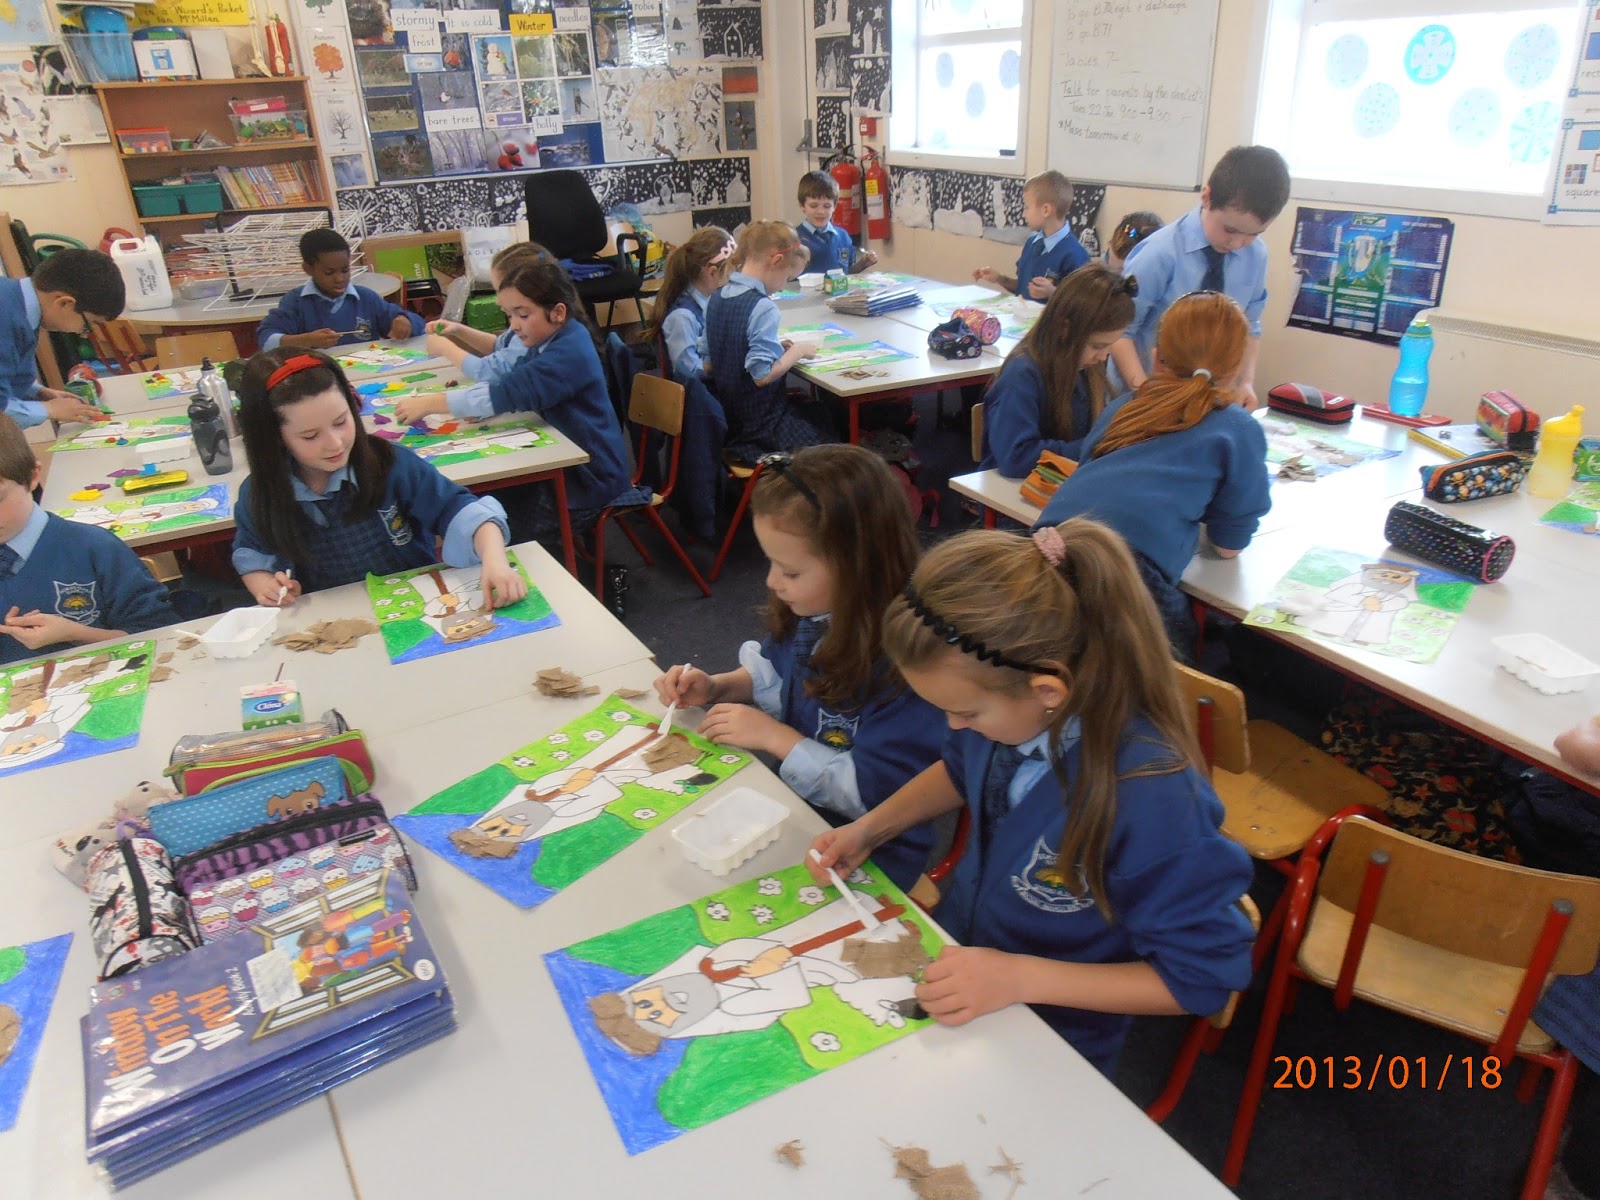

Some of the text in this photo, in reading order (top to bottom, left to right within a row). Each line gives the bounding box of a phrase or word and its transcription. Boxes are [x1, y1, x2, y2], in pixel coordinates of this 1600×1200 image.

[175, 4, 214, 15] Wizard's
[559, 9, 589, 23] needles
[396, 13, 435, 30] stormy
[474, 15, 493, 27] cold
[517, 19, 546, 31] Winter
[412, 34, 435, 47] frost
[1061, 80, 1082, 97] Talk
[428, 114, 474, 125] bare trees
[536, 120, 558, 133] holly
[228, 974, 245, 991] Book
[185, 984, 245, 1051] World
[143, 990, 198, 1065] On The
[101, 1007, 158, 1091] Window
